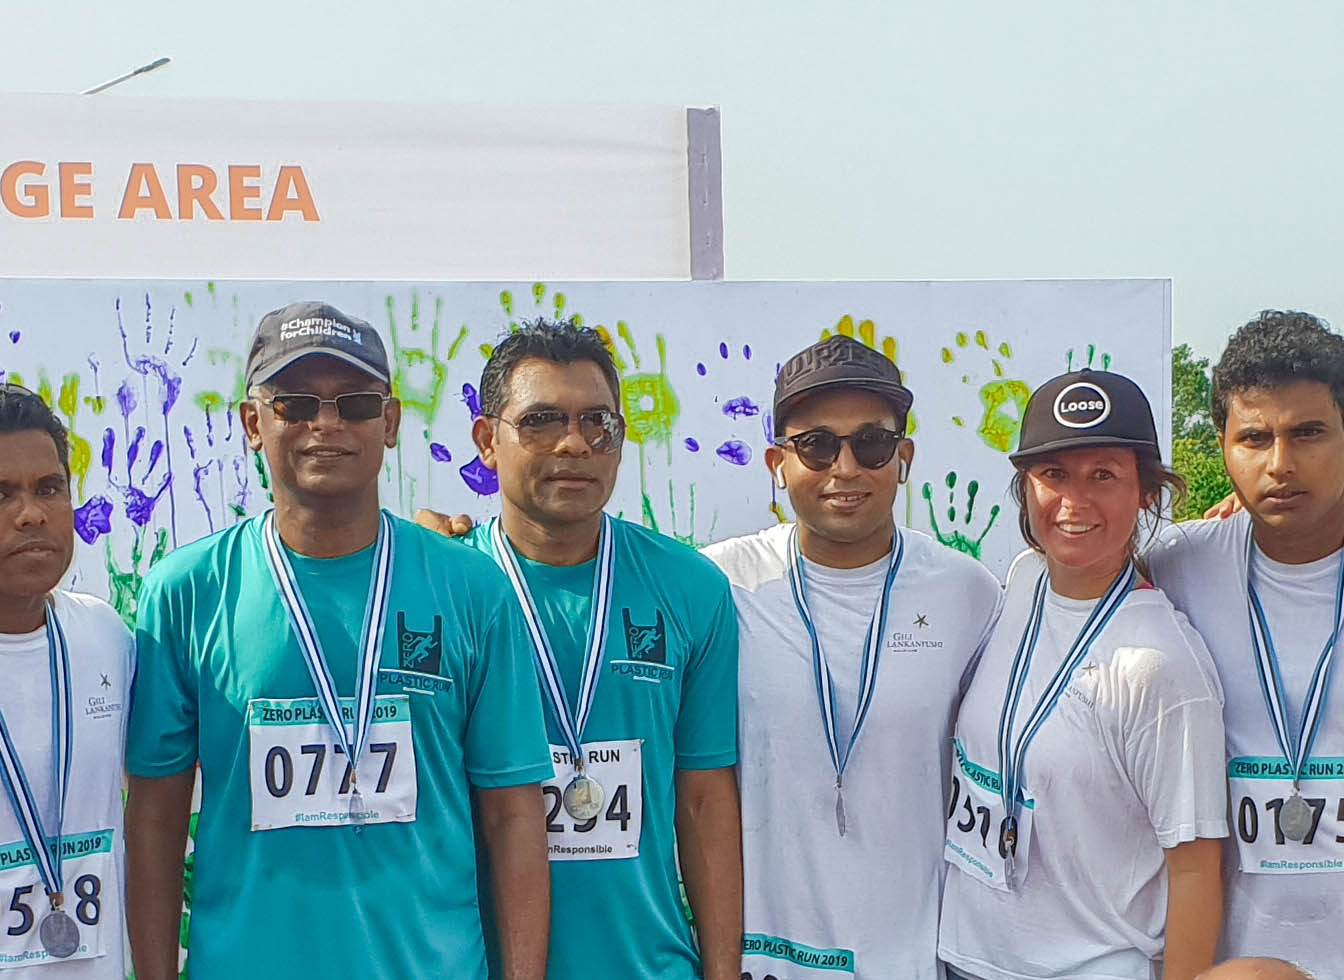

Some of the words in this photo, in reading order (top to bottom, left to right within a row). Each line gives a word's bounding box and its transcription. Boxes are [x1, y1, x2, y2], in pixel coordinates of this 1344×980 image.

[116, 162, 321, 222] AREA
[280, 317, 351, 333] #Champion
[611, 664, 659, 678] PLASTIC
[379, 673, 434, 690] PLASTIC
[262, 708, 293, 722] ZERO
[294, 708, 323, 720] PLAS
[588, 749, 620, 763] RUN
[264, 742, 398, 798] 0777
[1235, 761, 1259, 775] ZERO
[1309, 763, 1334, 776] RUN
[0, 848, 32, 867] PLAS
[77, 836, 102, 853] 2019
[1259, 860, 1344, 870] #IamResponsible
[743, 939, 762, 951] ERO
[797, 949, 821, 965] RUN
[820, 953, 849, 967] 2019
